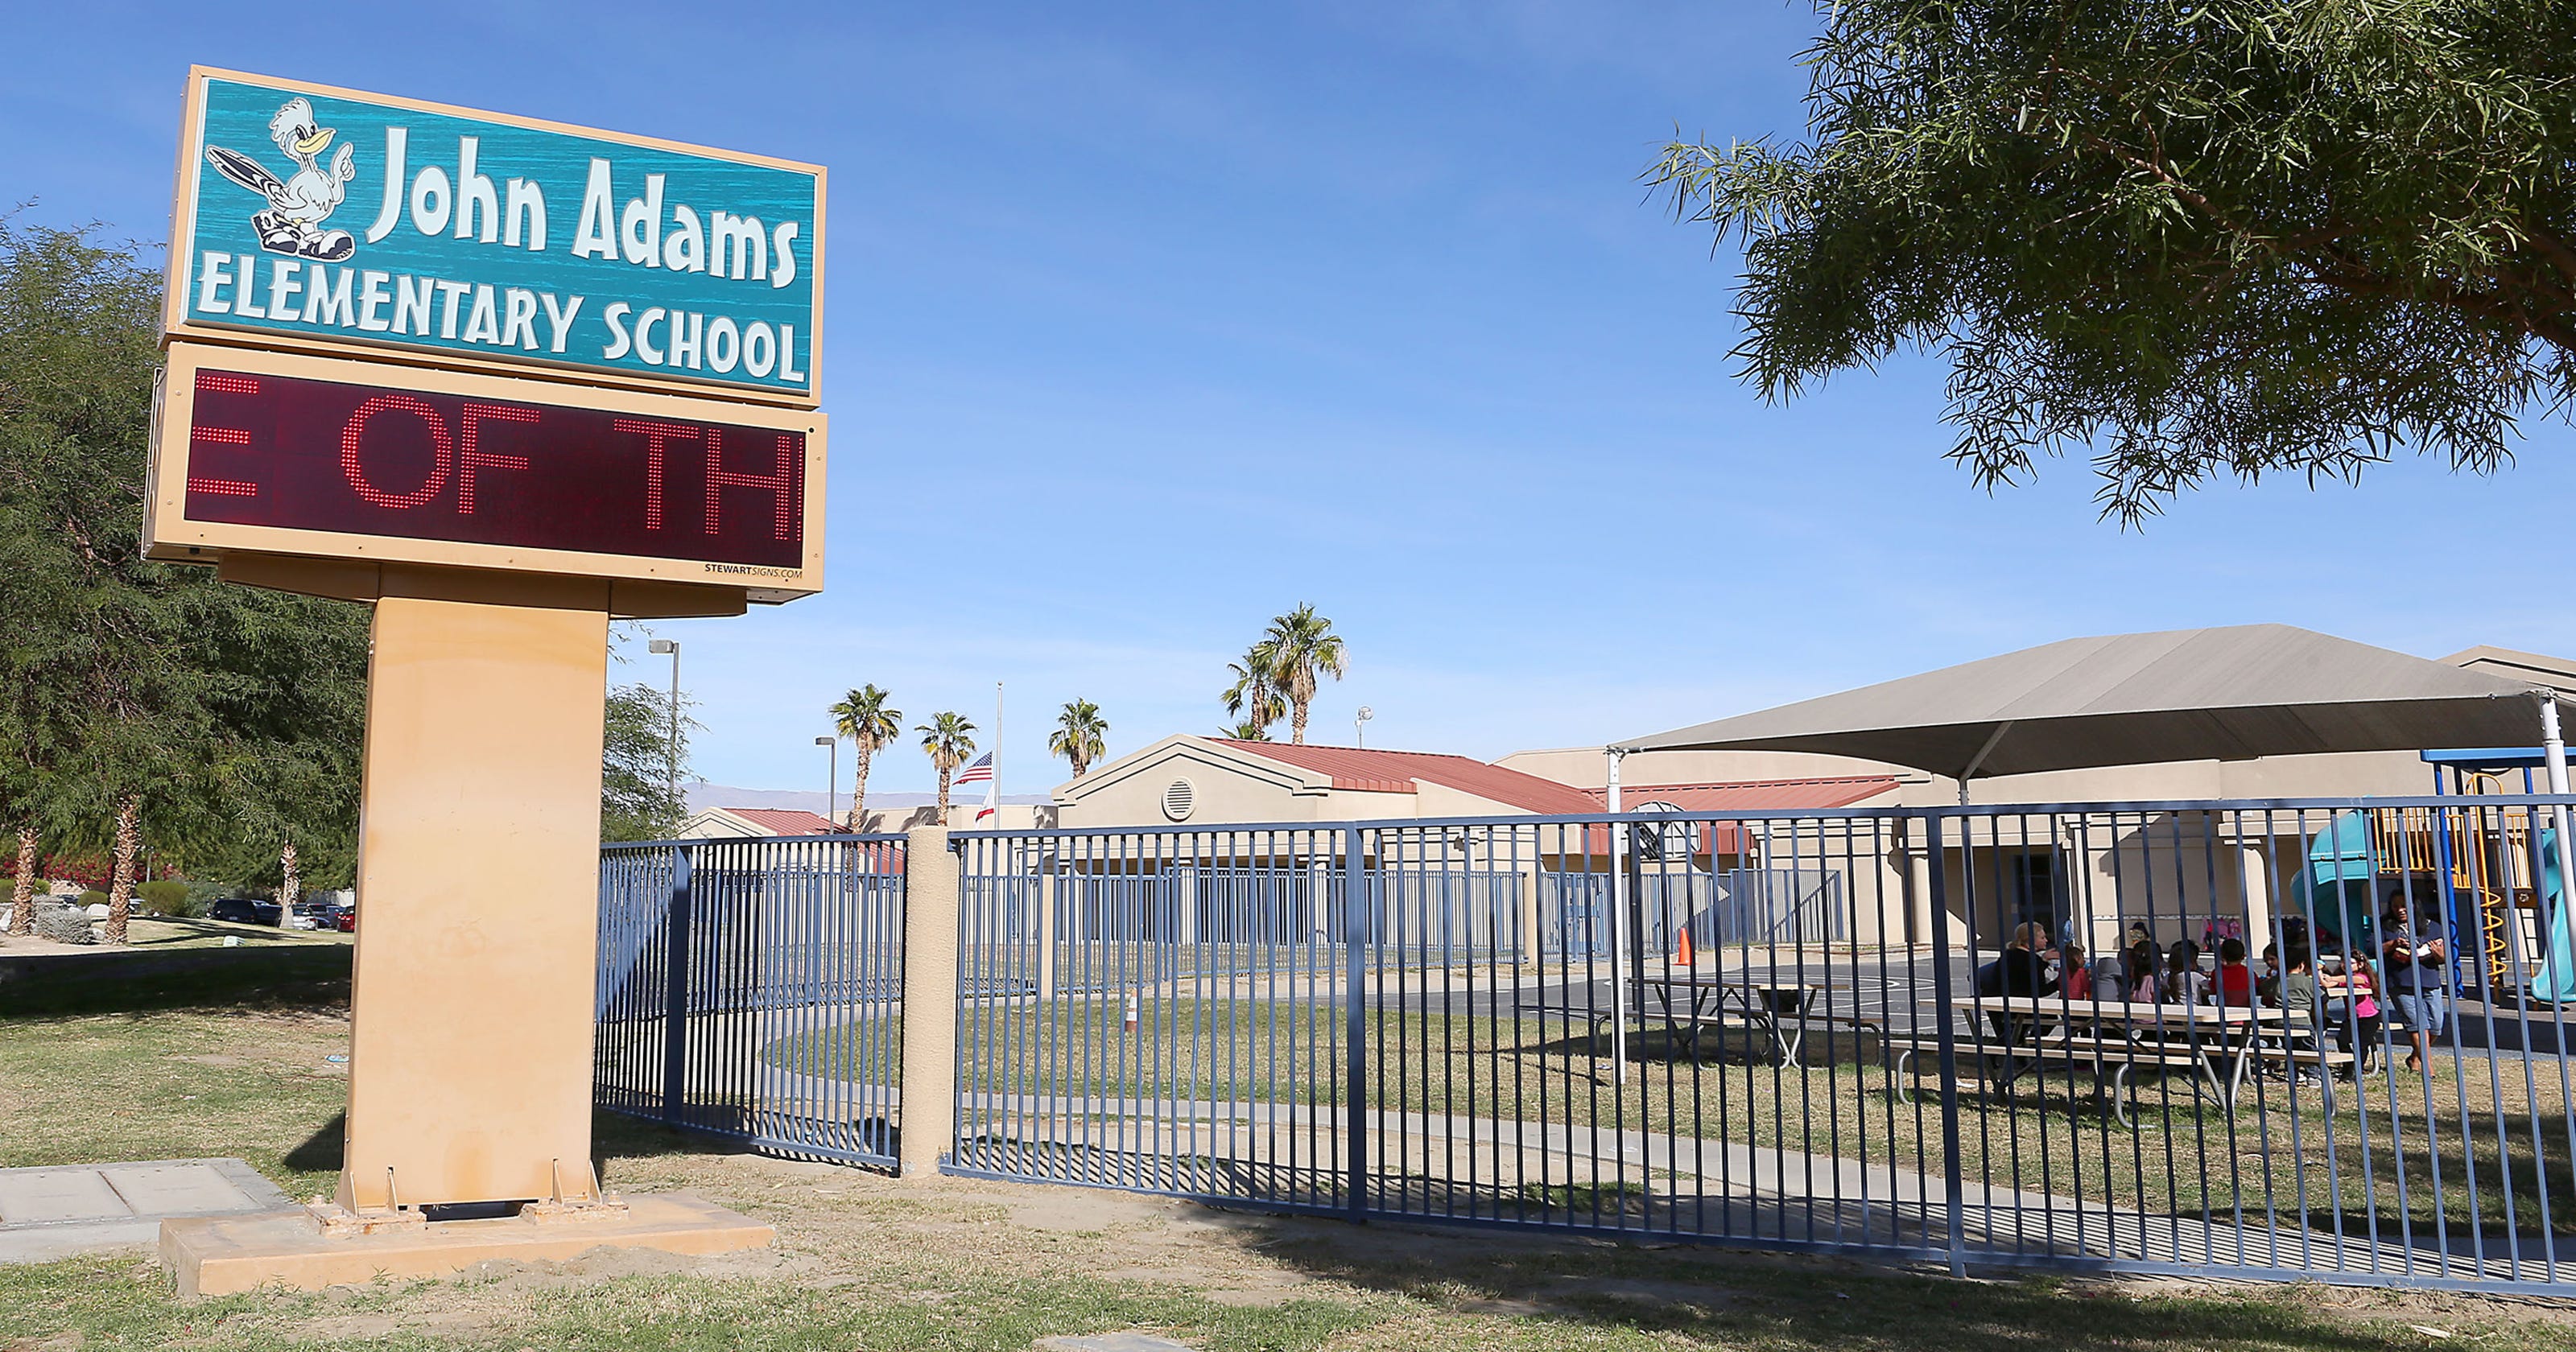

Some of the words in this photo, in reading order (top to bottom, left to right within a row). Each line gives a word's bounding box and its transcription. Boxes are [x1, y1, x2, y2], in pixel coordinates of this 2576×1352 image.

[365, 126, 548, 254] John
[571, 158, 801, 290] Adams
[196, 250, 585, 354] ELEMENTARY
[603, 301, 805, 384] SCHOOL
[340, 394, 540, 514] OF
[613, 418, 804, 542] TH
[704, 563, 803, 579] STEWARTSIGNS.COM
